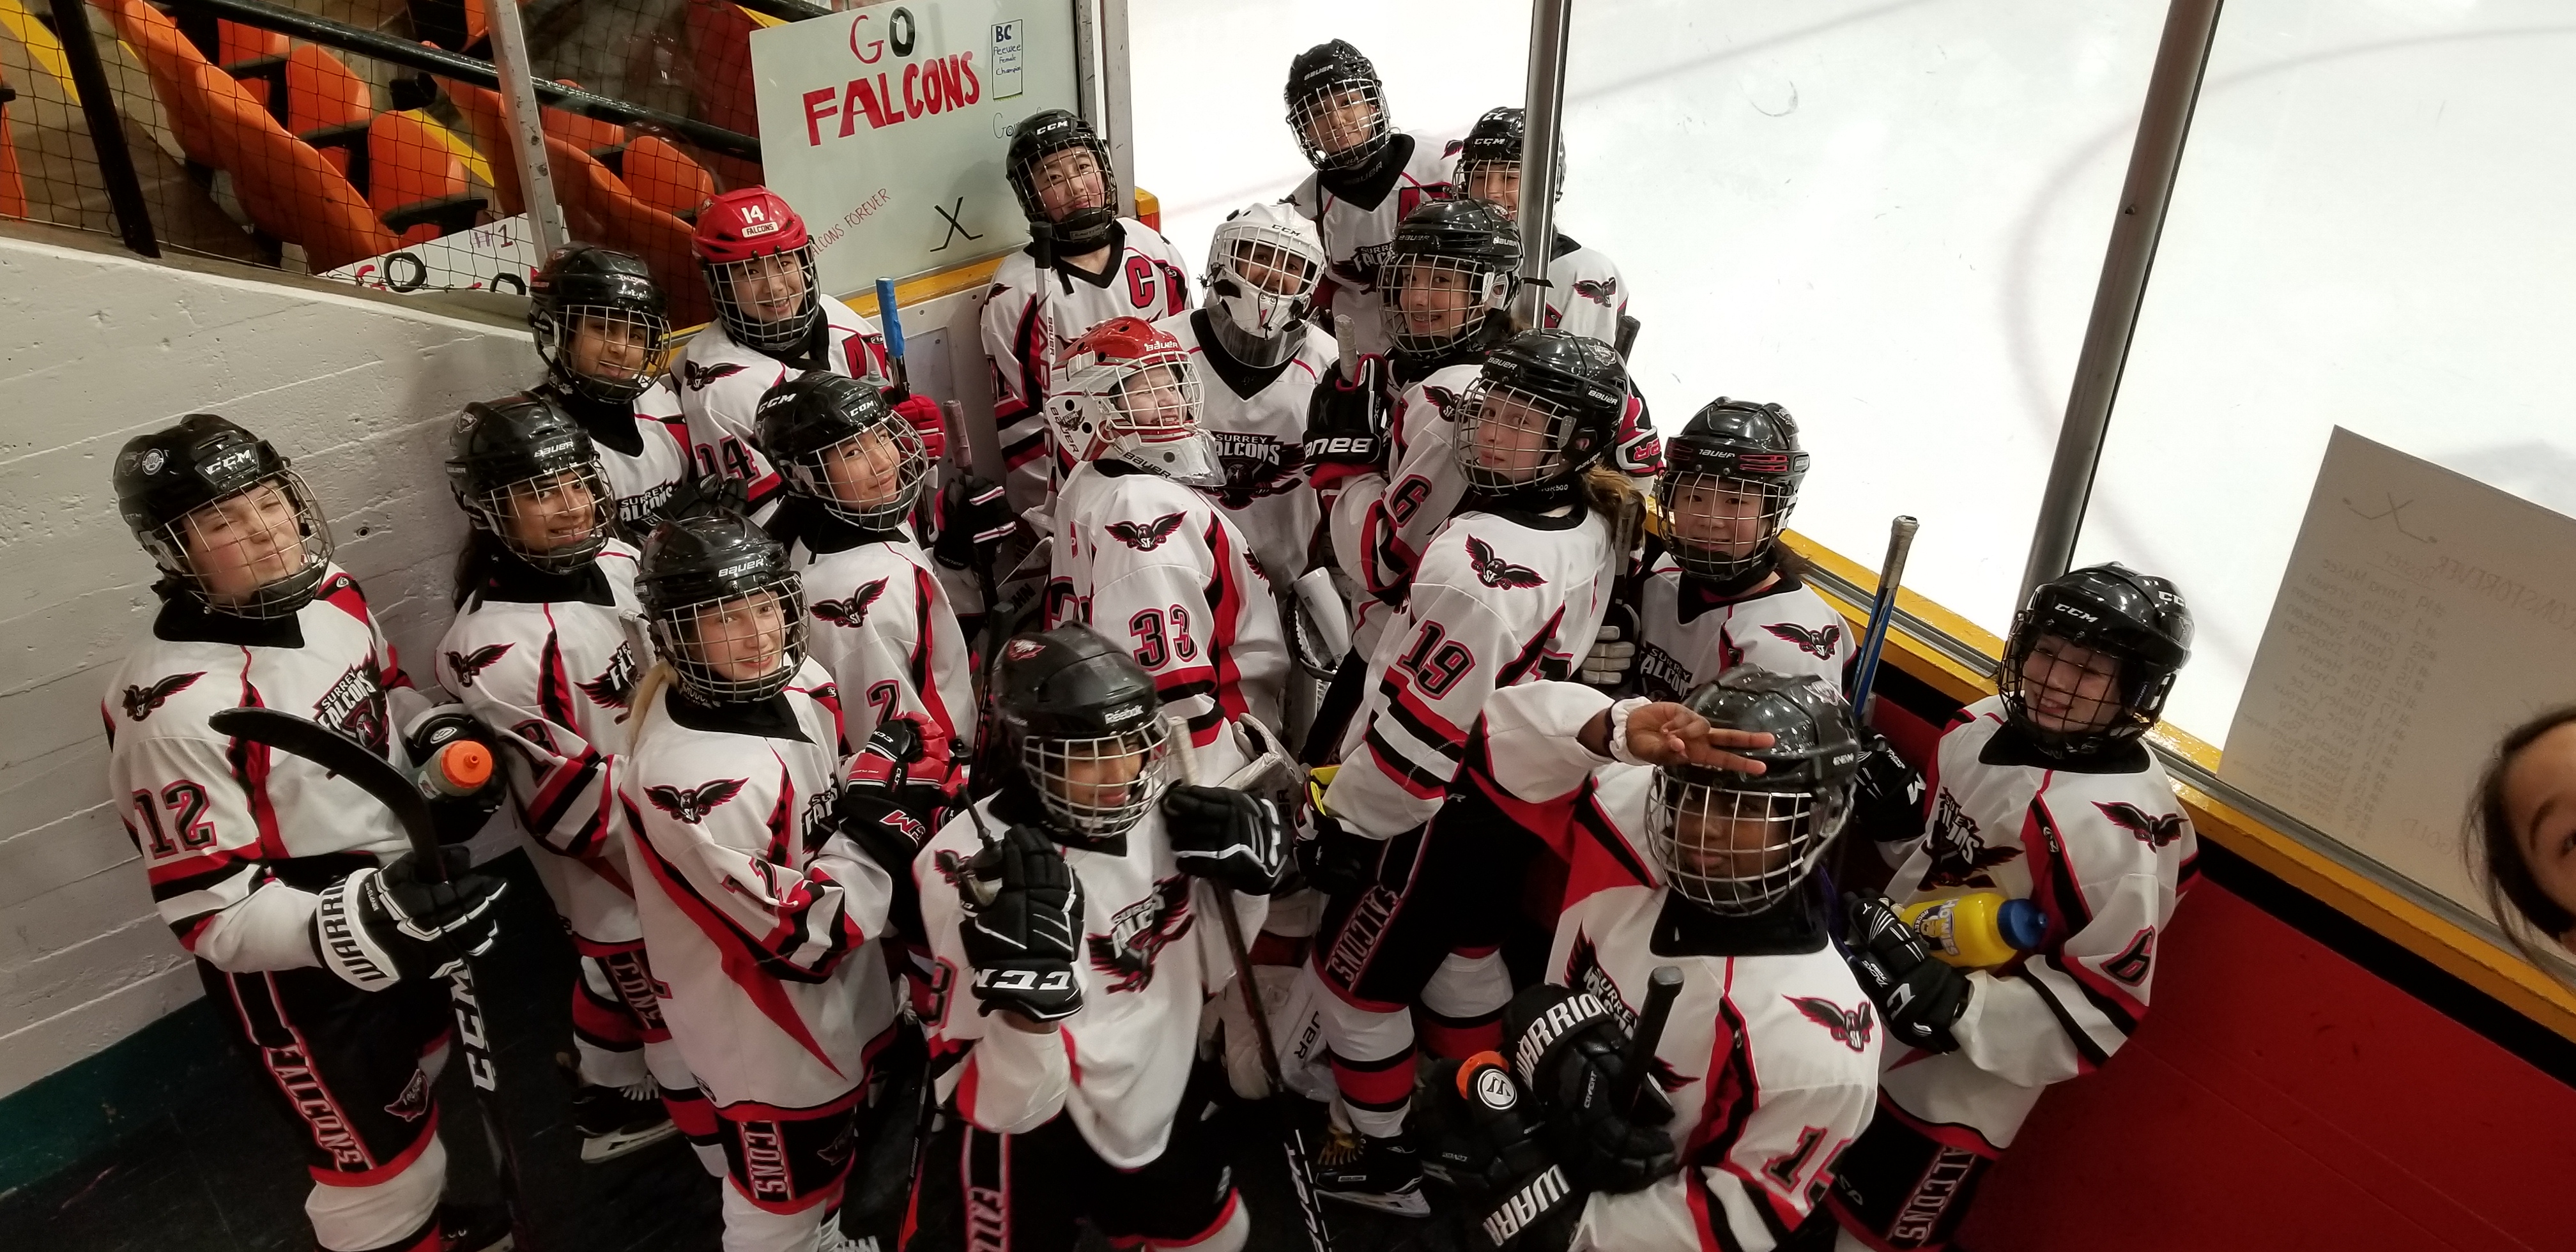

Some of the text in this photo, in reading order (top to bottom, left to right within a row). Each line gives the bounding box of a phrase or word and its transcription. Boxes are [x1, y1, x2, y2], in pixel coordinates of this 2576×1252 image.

[849, 6, 916, 64] GO
[995, 24, 1012, 42] BC
[1304, 65, 1333, 80] BAUER
[803, 50, 979, 147] FALCONS
[1037, 120, 1068, 135] CCM
[1482, 112, 1508, 122] 22
[1474, 138, 1505, 146] CCM
[741, 205, 764, 224] 14
[811, 188, 891, 257] ALCONS FOREVER
[747, 224, 774, 236] FALCONS
[1271, 224, 1301, 236] CCM
[1125, 255, 1155, 310] C
[1146, 341, 1177, 351] BAUER
[1487, 356, 1517, 370] BAUER
[758, 393, 797, 415] CCM
[1588, 389, 1618, 406] BAUER
[534, 441, 573, 457] BAUER
[1216, 434, 1268, 444] SURREY
[204, 449, 251, 475] CCM
[694, 435, 762, 489] 14
[1124, 452, 1171, 478] BAUER
[1215, 441, 1280, 466] ALCONS
[1575, 451, 1601, 472] BAUER
[1388, 474, 1432, 528] 6
[718, 558, 764, 577] BAUER
[2158, 591, 2187, 607] CC
[2055, 603, 2099, 623] CCM
[1129, 604, 1198, 671] 33
[1395, 620, 1476, 699] 19
[321, 669, 356, 710] SURREY
[1640, 654, 1690, 701] ALCON
[1105, 705, 1144, 724] Reebok
[132, 780, 217, 859] 12
[321, 878, 391, 982] WARRI
[611, 963, 663, 1020] CONS
[450, 970, 495, 1092] CCM
[1294, 1011, 1320, 1060] UER
[1516, 993, 1611, 1090] WARRIO
[268, 1044, 365, 1164] FALCONS
[742, 1122, 786, 1193] CONS
[1894, 1148, 1974, 1239] ALCONS
